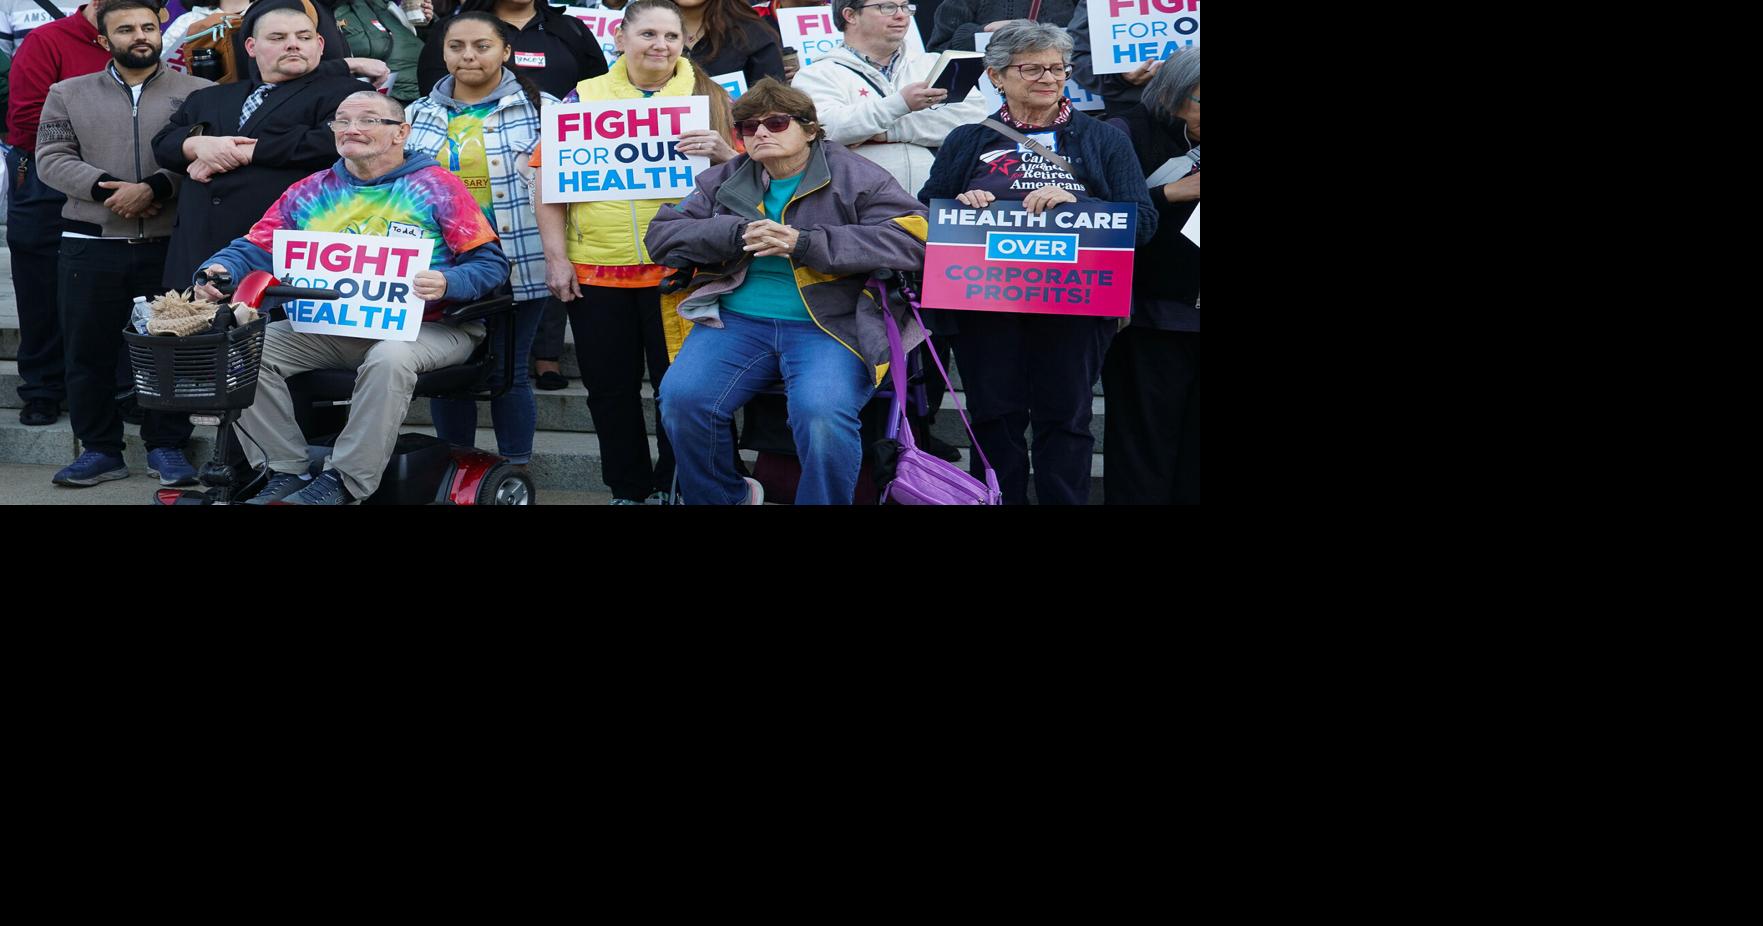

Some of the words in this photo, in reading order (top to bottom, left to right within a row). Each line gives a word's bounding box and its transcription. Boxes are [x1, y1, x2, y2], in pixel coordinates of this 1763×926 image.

[1109, 0, 1200, 17] FIG
[1112, 21, 1167, 39] FOR
[803, 39, 843, 54] FO
[1113, 40, 1193, 63] HEA
[558, 106, 691, 142] FIGHT
[559, 148, 609, 167] FOR
[614, 141, 689, 163] OUR
[559, 166, 694, 193] HEALTH
[1010, 179, 1086, 191] Americans
[1022, 169, 1074, 180] Retired
[938, 208, 1046, 228] HEALTH
[1055, 211, 1129, 229] CARE
[393, 226, 417, 237] Todd
[997, 239, 1068, 256] OVER
[284, 240, 419, 278] FIGHT
[945, 264, 1113, 287] CORPORATE
[290, 277, 329, 289] OR
[333, 277, 410, 304] OUR
[965, 284, 1091, 305] PROFITS!
[285, 299, 407, 331] HEALTH
